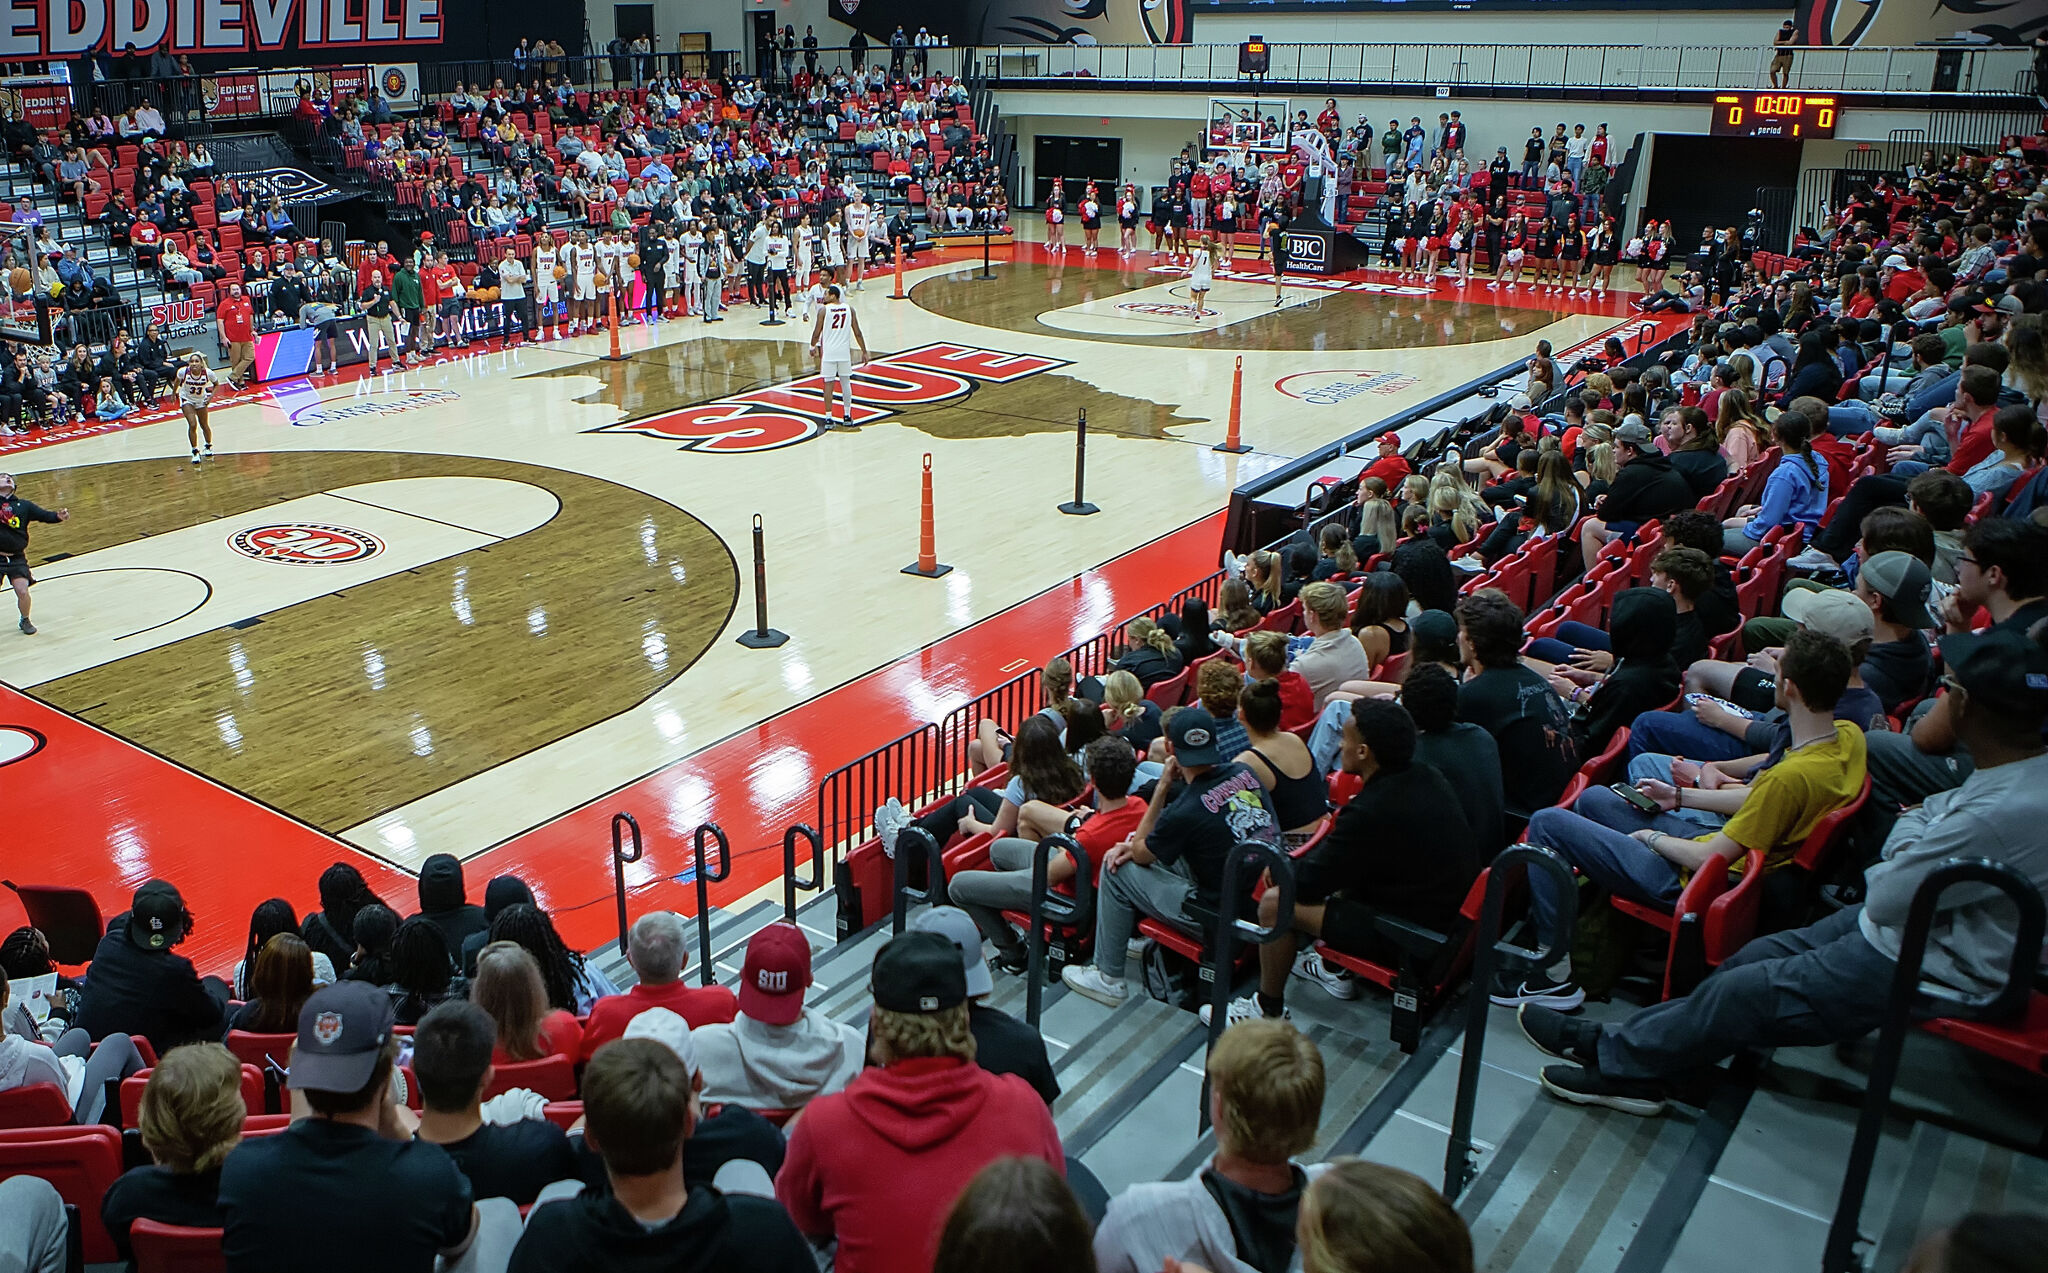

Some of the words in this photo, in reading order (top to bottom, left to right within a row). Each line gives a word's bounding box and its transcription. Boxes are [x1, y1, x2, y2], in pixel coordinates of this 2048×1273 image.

[0, 0, 443, 57] EDDIEVILLE
[1755, 97, 1801, 114] 10:00
[1729, 107, 1742, 124] 0
[1818, 109, 1833, 127] 0
[1757, 127, 1782, 136] period
[1292, 239, 1321, 257] BJC
[1286, 261, 1324, 271] HealthCare
[150, 298, 205, 326] SIUE
[832, 313, 846, 329] 21
[159, 323, 208, 341] OUGARS
[346, 305, 489, 355] WLOME
[579, 341, 1077, 454] SIUE
[758, 969, 788, 990] SIU
[1397, 996, 1414, 1008] FF
